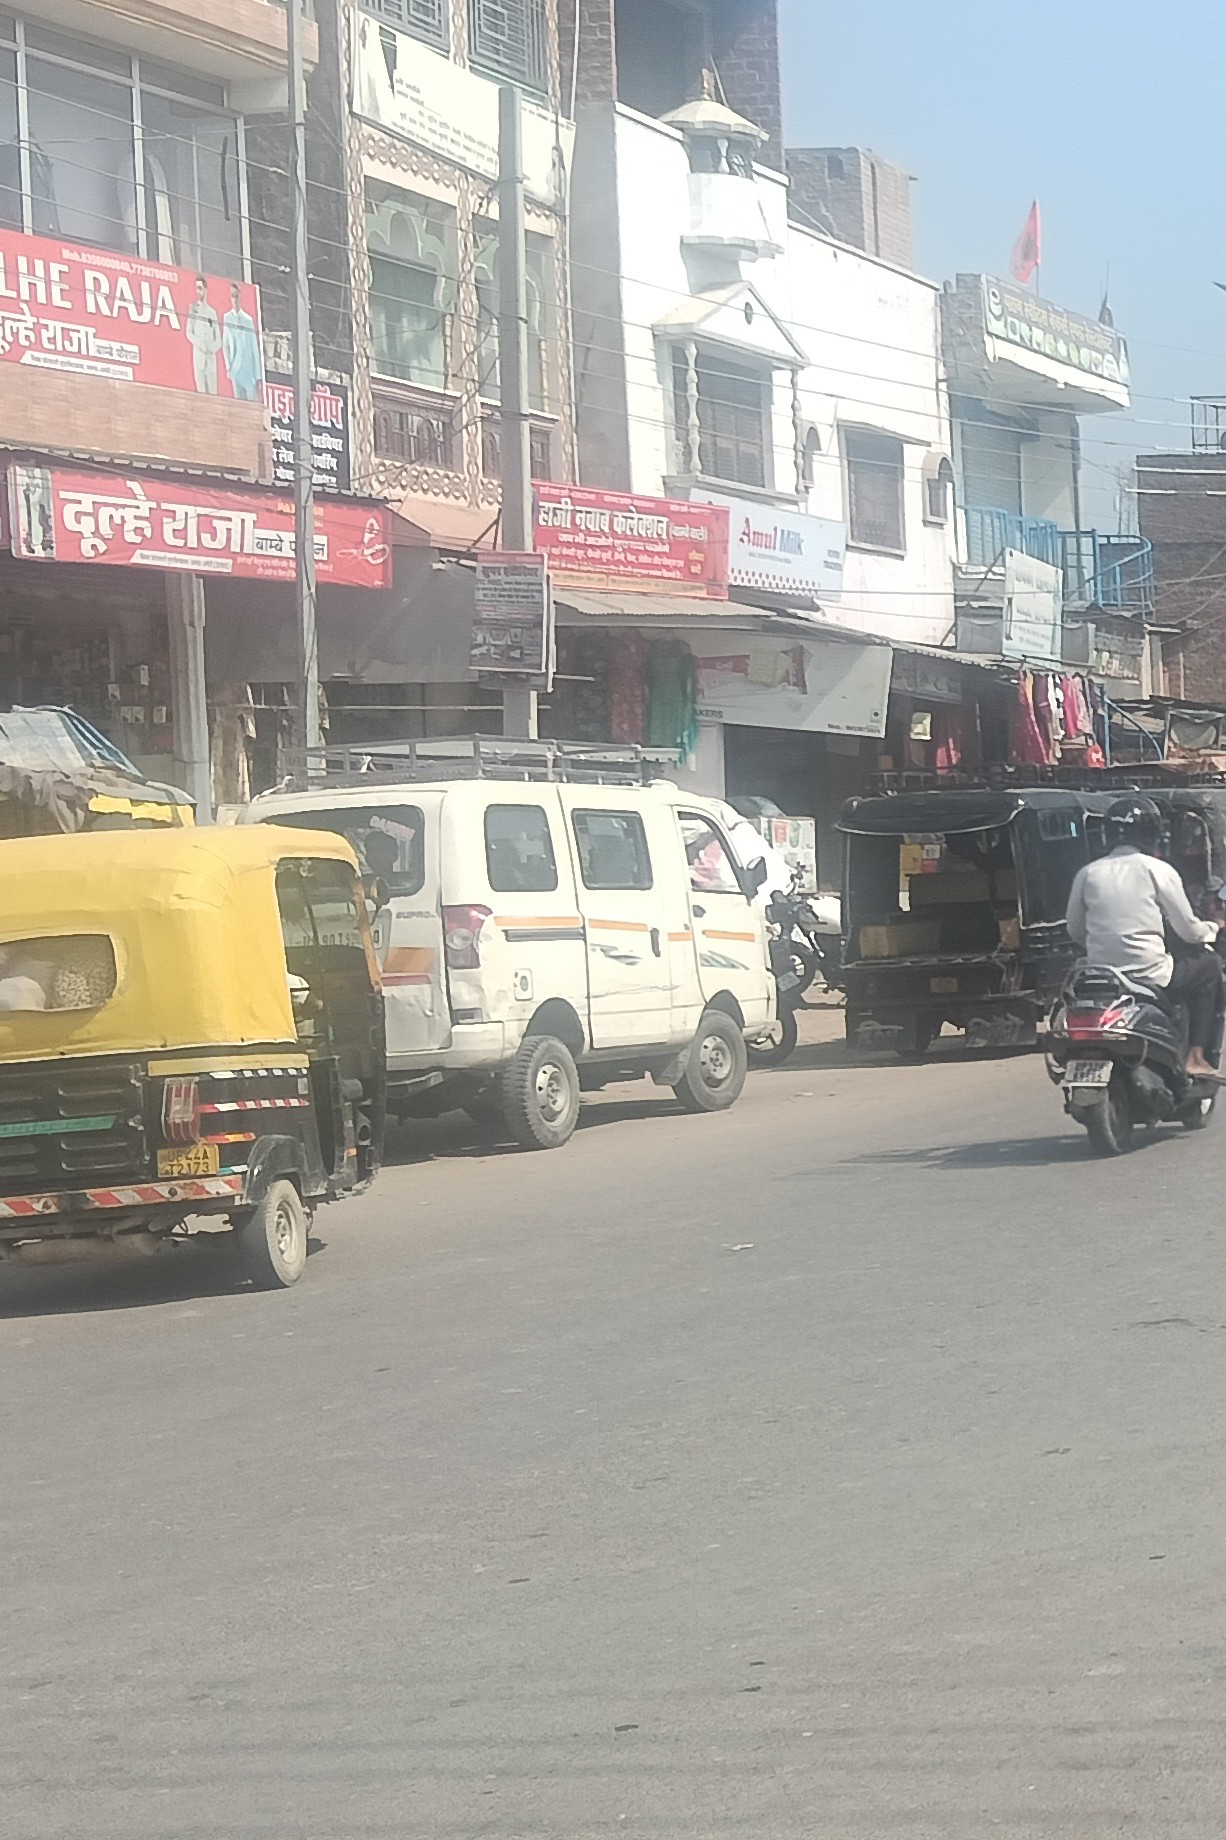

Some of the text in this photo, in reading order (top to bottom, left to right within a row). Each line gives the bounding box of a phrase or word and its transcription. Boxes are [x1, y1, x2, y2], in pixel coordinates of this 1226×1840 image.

[84, 269, 181, 330] RAJA
[39, 318, 96, 355] राजा
[59, 481, 156, 558] दूल्हे
[161, 502, 257, 553] राजा
[538, 498, 574, 529] हाजी
[575, 505, 611, 533] नवाब
[739, 517, 805, 556] Amul Milk
